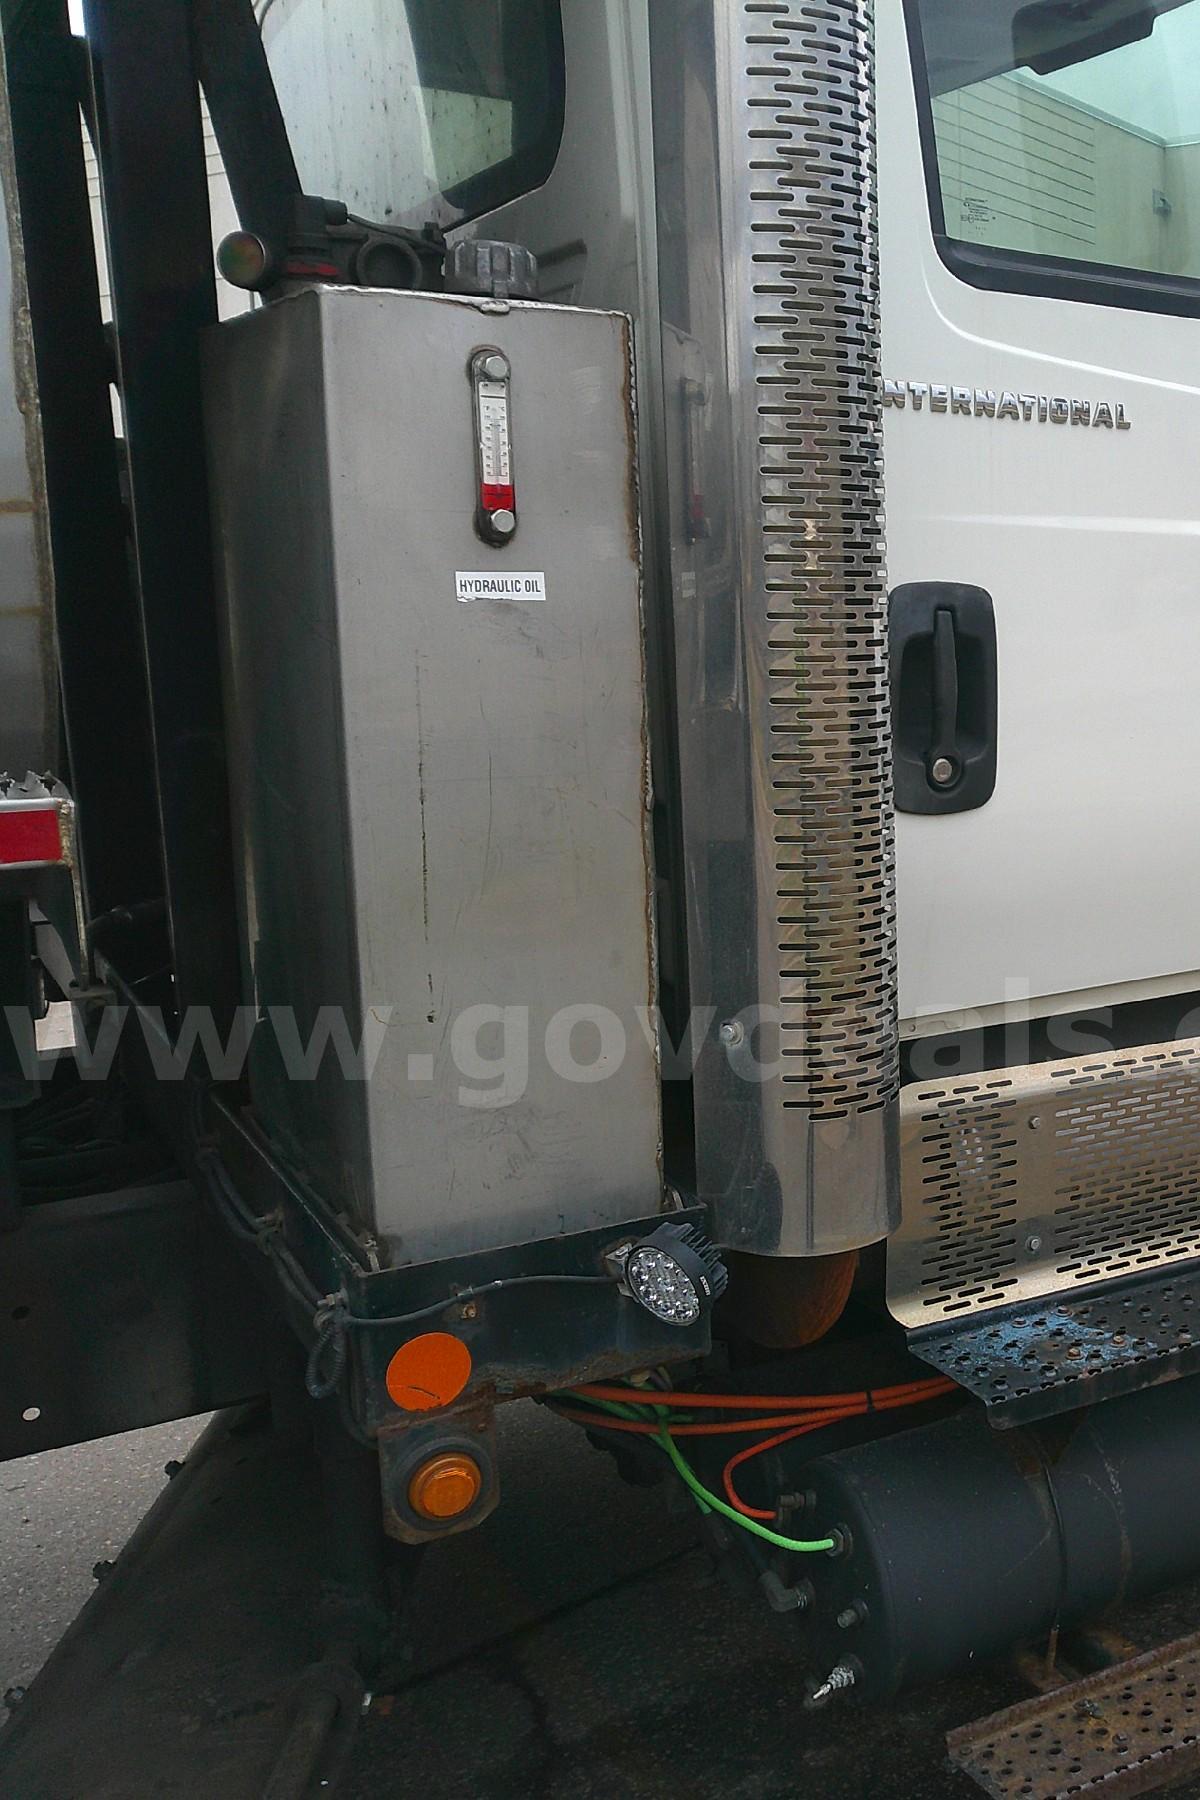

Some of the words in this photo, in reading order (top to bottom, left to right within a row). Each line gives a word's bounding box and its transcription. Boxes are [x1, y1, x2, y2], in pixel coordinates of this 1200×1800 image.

[883, 378, 1131, 429] NTERNATIONAL
[459, 579, 522, 593] HYDRAULIC
[524, 579, 542, 593] OIL
